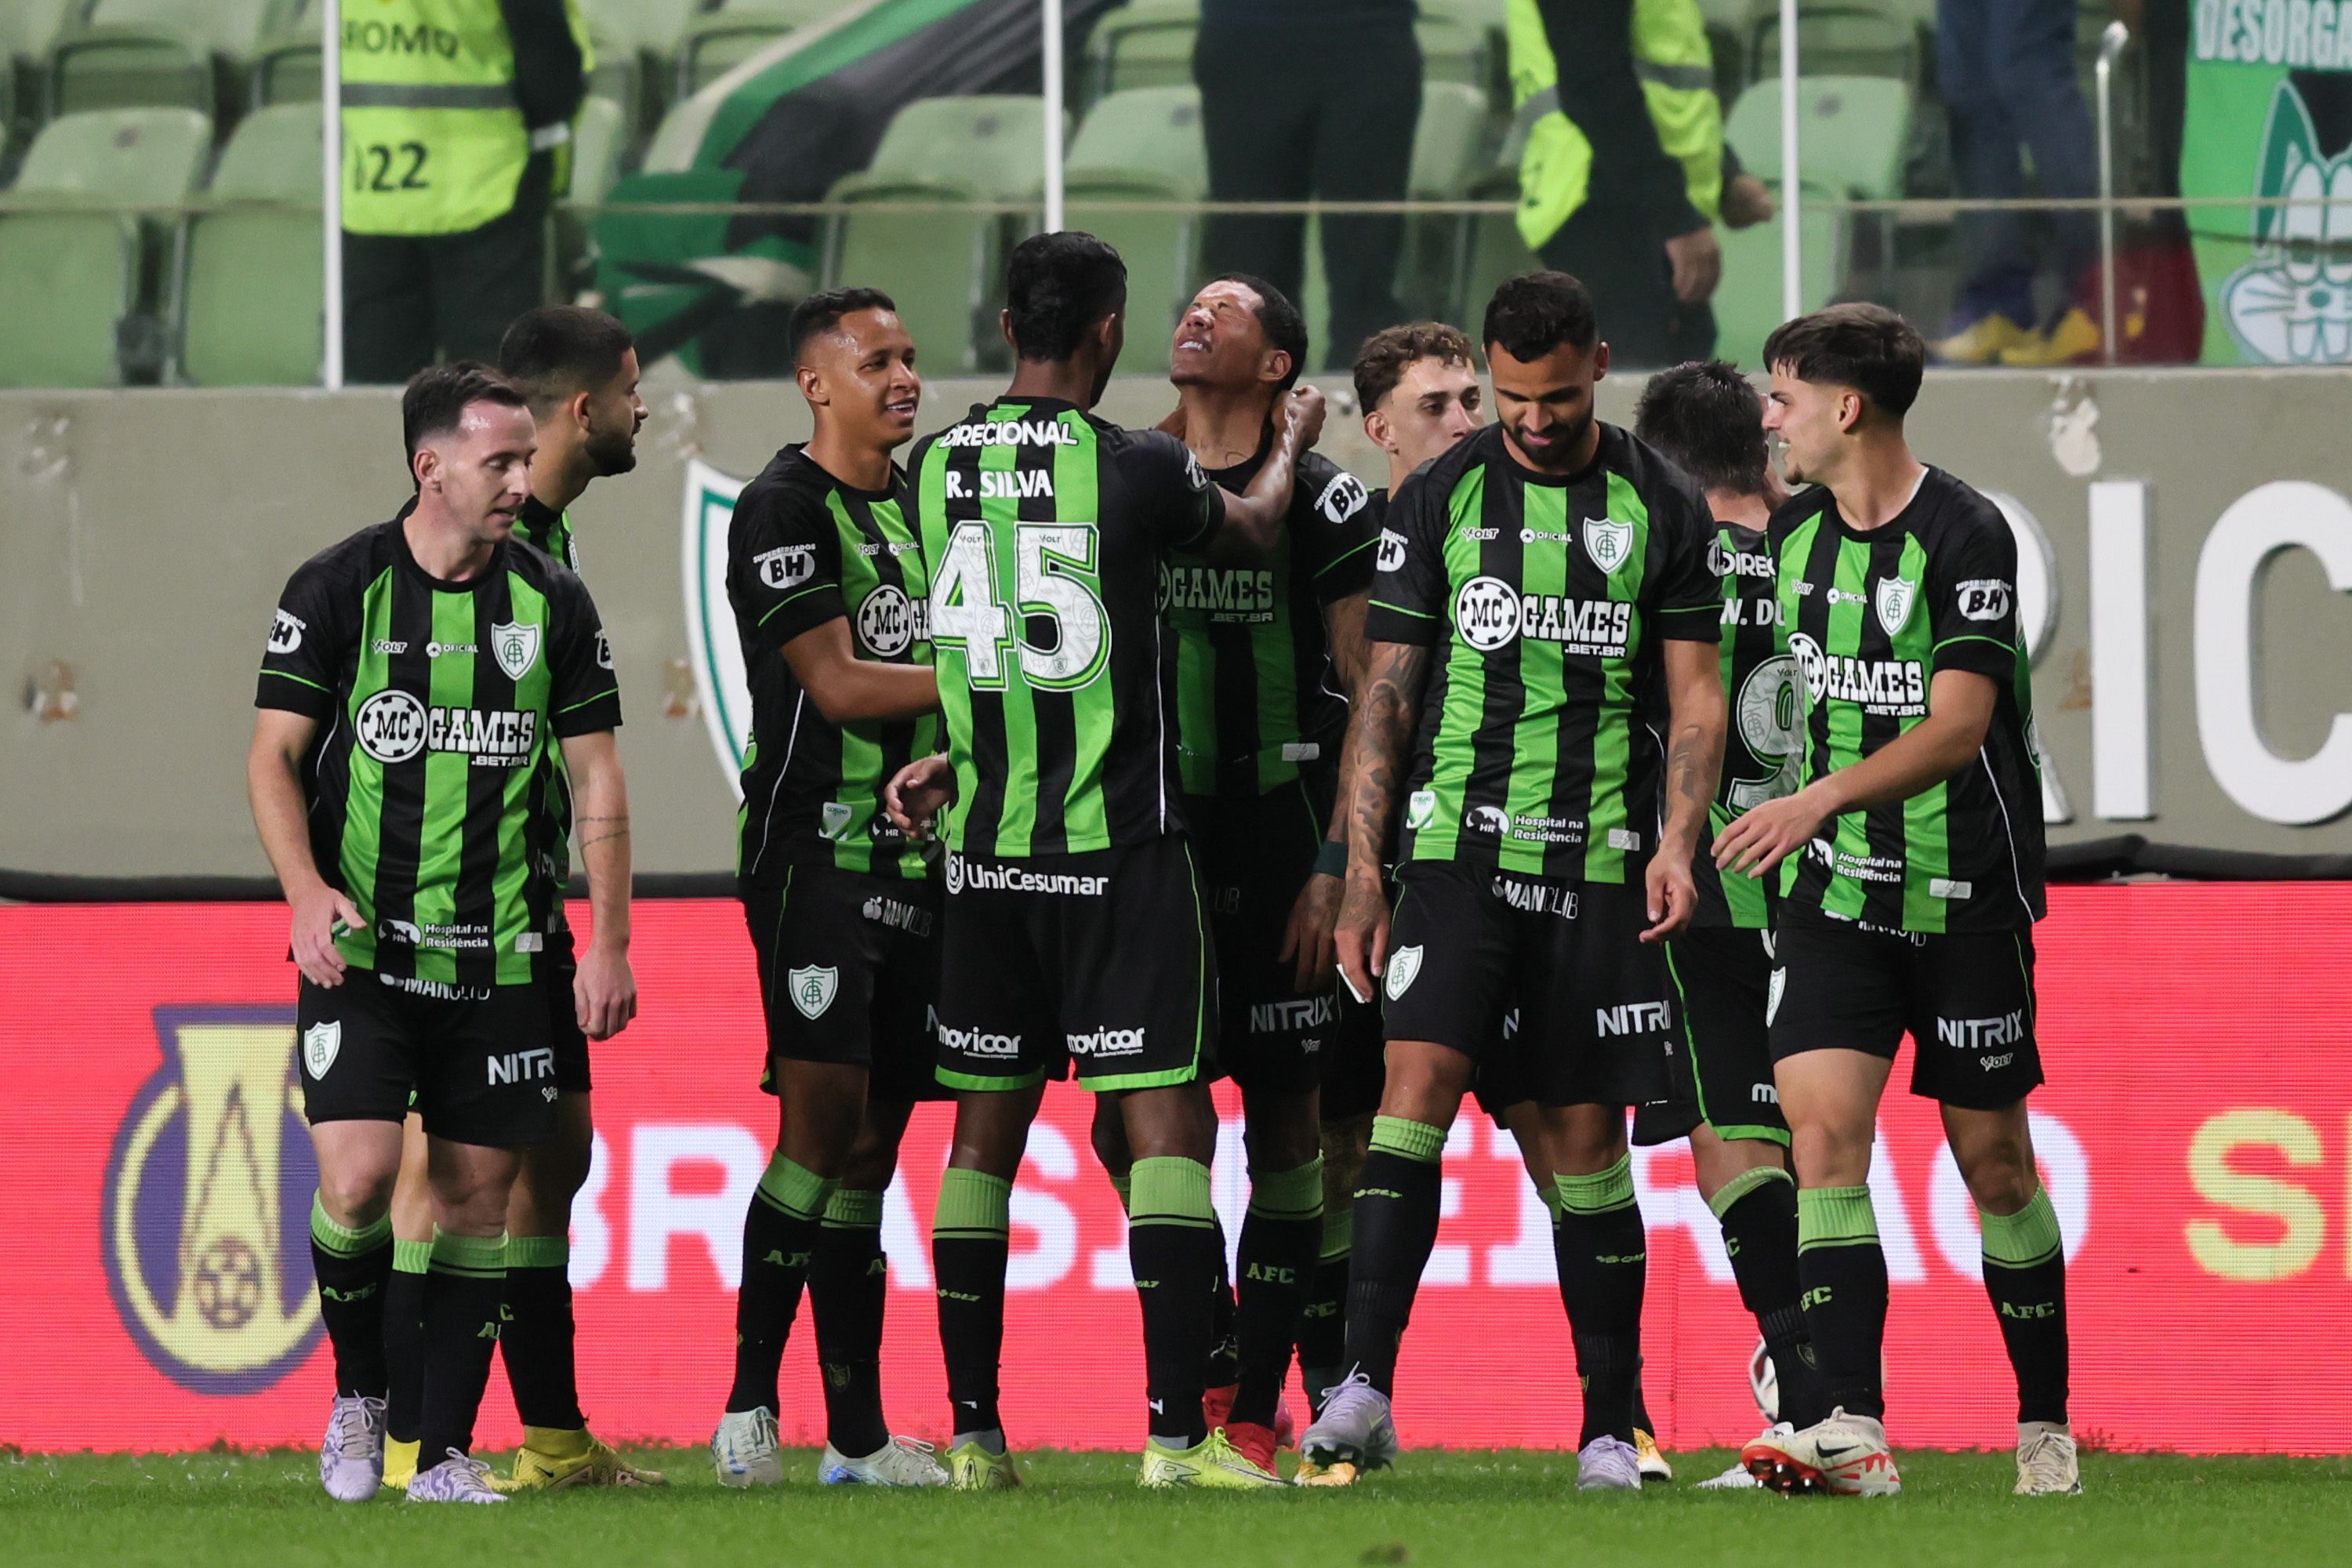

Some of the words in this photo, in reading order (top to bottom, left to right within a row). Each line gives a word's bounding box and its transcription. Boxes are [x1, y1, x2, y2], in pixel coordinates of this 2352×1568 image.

[938, 420, 1079, 448] DIRECIONAL
[946, 470, 973, 499] R.
[979, 469, 1054, 498] SILVA
[1329, 477, 1364, 516] BH
[1461, 527, 1499, 543] VOLT
[1537, 531, 1573, 543] OFICIAL
[769, 553, 805, 584] BH
[1171, 567, 1273, 610] GAMES
[1966, 588, 2003, 613] BH
[929, 521, 1112, 691] 45
[1471, 597, 1503, 628] MC
[1521, 594, 1632, 644] GAMES
[1719, 597, 1748, 626] N.
[873, 604, 901, 635] MC
[372, 639, 408, 654] VOLT
[443, 644, 479, 653] OFICIAL
[1565, 643, 1626, 657] .BET.BR
[1826, 655, 1925, 703] GAMES
[1865, 704, 1926, 716] .BET.BR
[375, 710, 410, 741] MC
[428, 707, 535, 753] GAMES
[1726, 654, 1806, 819] 9
[471, 755, 528, 767] .BET.BR
[885, 829, 899, 837] HR
[1479, 823, 1495, 833] HR
[1515, 815, 1566, 830] Hospital
[1569, 820, 1584, 830] na
[1514, 829, 1582, 844] Residência
[1836, 864, 1901, 883] Residência
[1838, 852, 1885, 868] Hospital
[1886, 858, 1902, 869] na
[967, 864, 1109, 895] UniCesumar
[425, 924, 470, 935] Hospital
[474, 925, 488, 934] na
[426, 937, 488, 948] Residência
[1250, 994, 1334, 1033] NITRIX
[1596, 1000, 1671, 1037] NITRI
[938, 1024, 1022, 1054] movicar
[1066, 1025, 1145, 1054] movicar
[1936, 1008, 2024, 1049] NITRIX
[1980, 1052, 2013, 1073] VOLT
[2183, 1106, 2352, 1281] S
[1246, 1262, 1295, 1284] AFC
[1800, 1286, 1833, 1312] FC
[2001, 1301, 2055, 1319] AFC
